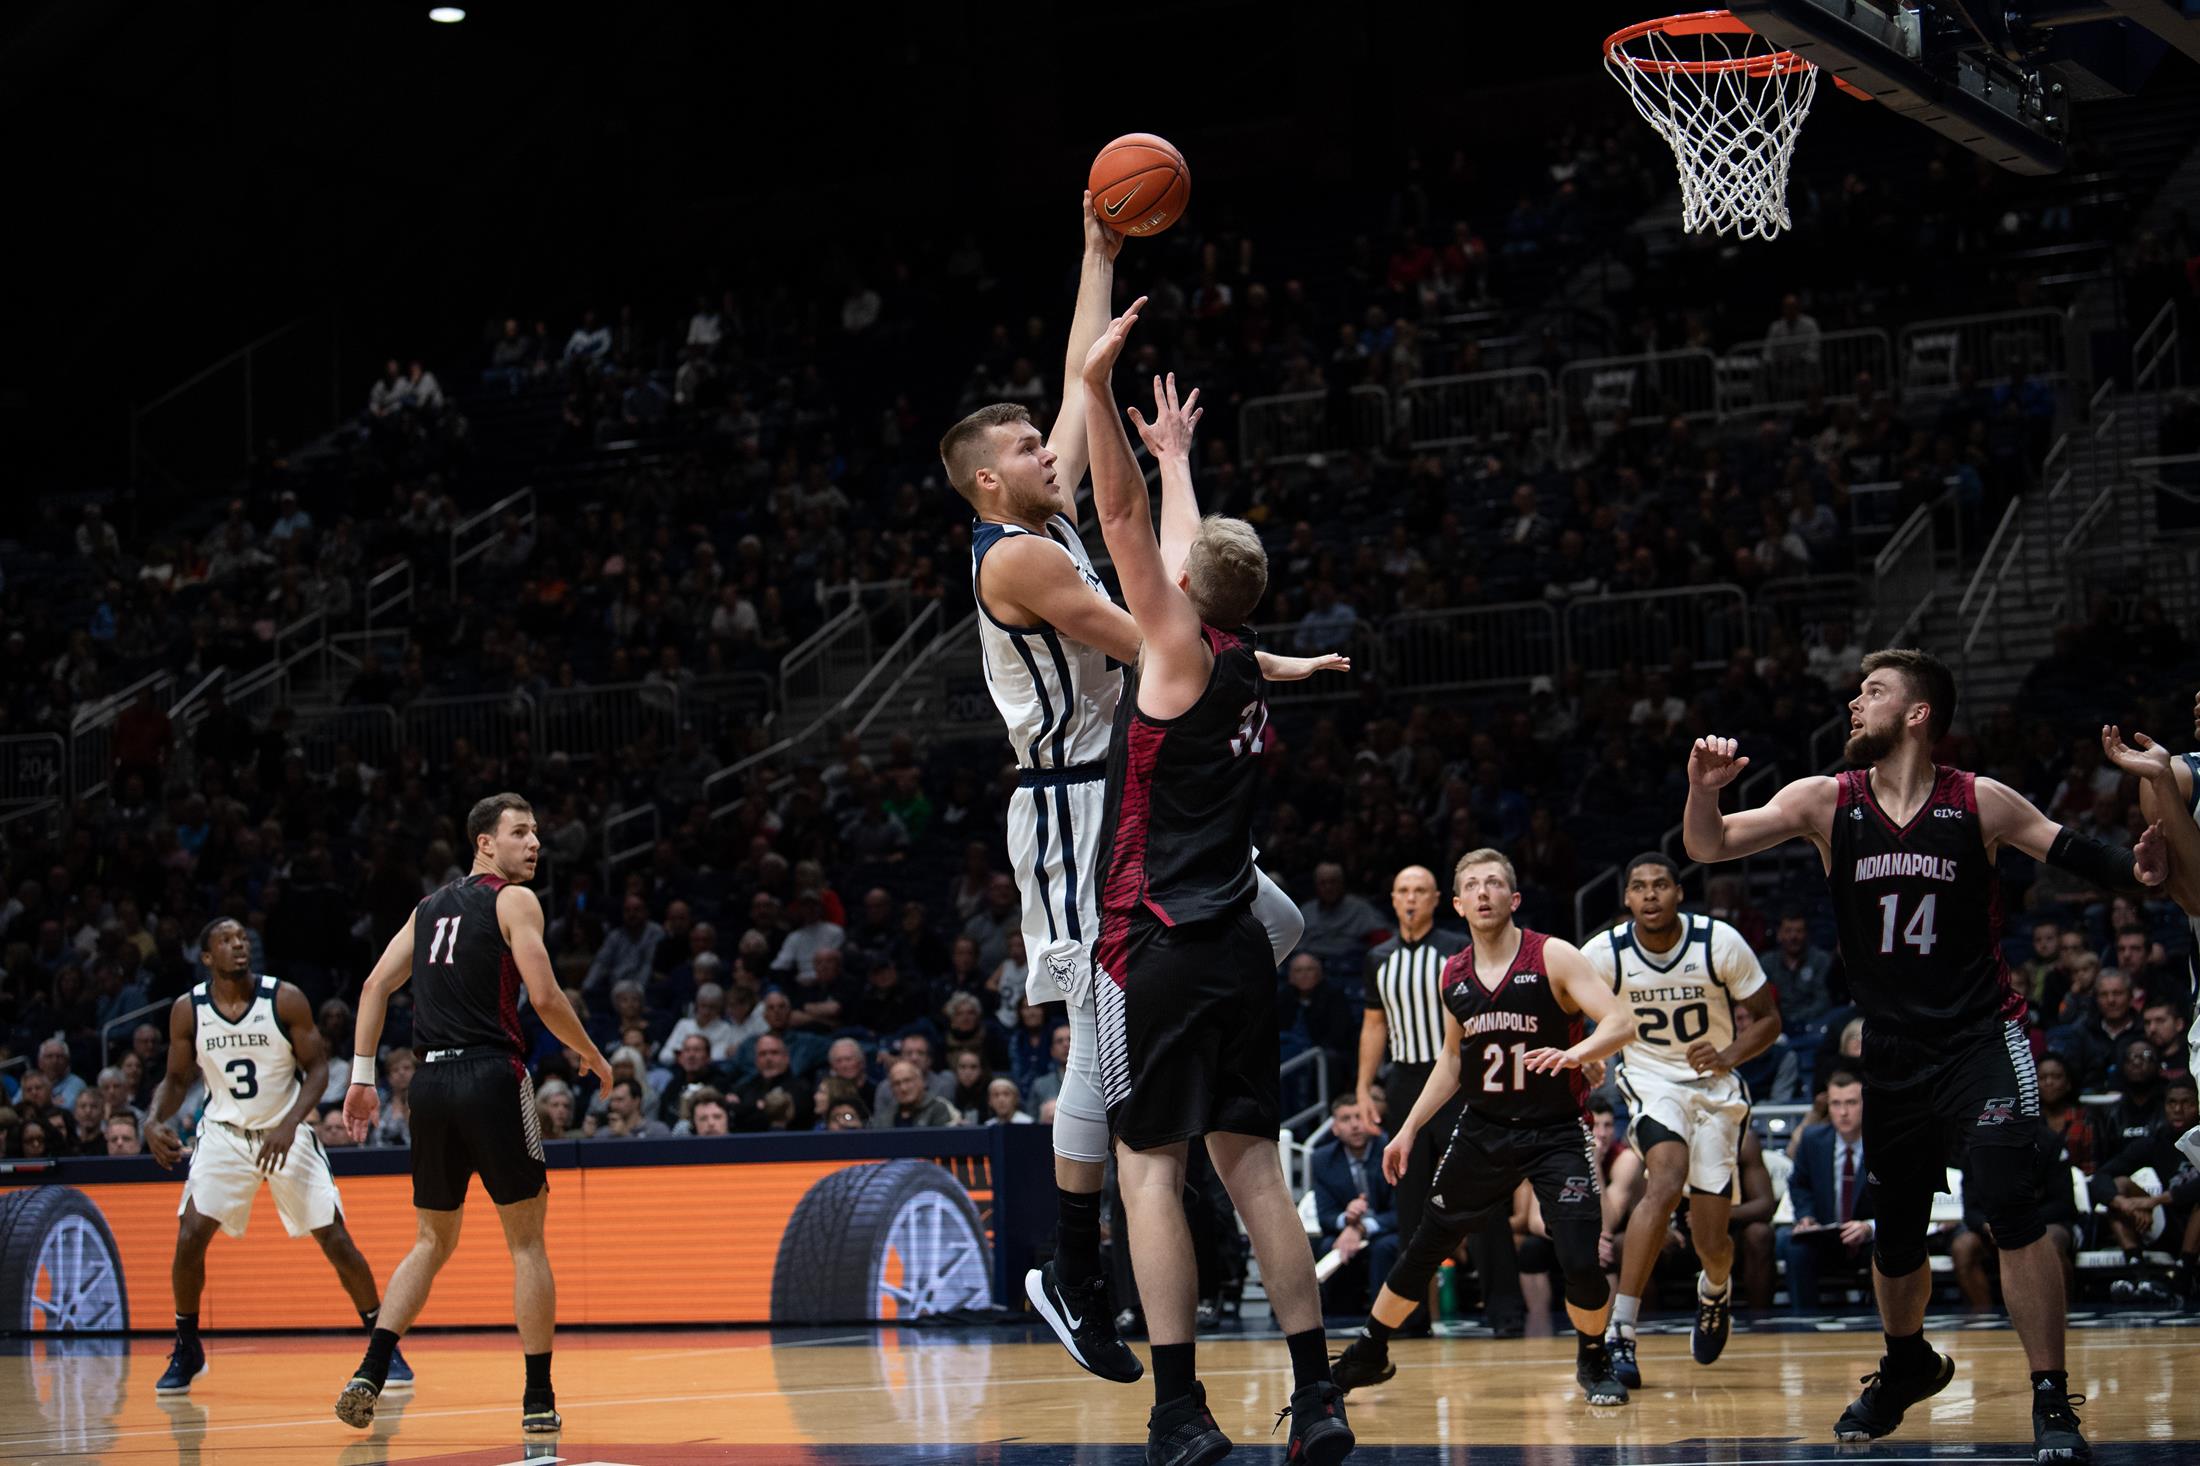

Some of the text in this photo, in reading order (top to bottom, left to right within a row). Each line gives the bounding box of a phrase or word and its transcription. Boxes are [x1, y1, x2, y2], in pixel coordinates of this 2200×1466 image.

[1933, 808, 1963, 819] GLVC
[428, 915, 462, 964] 11
[1879, 893, 1937, 955] 14
[1629, 986, 1706, 1003] BUTLER
[206, 1034, 270, 1051] BUTLER
[1634, 1003, 1709, 1046] 20
[225, 1059, 258, 1100] 3
[1482, 1042, 1527, 1093] 21
